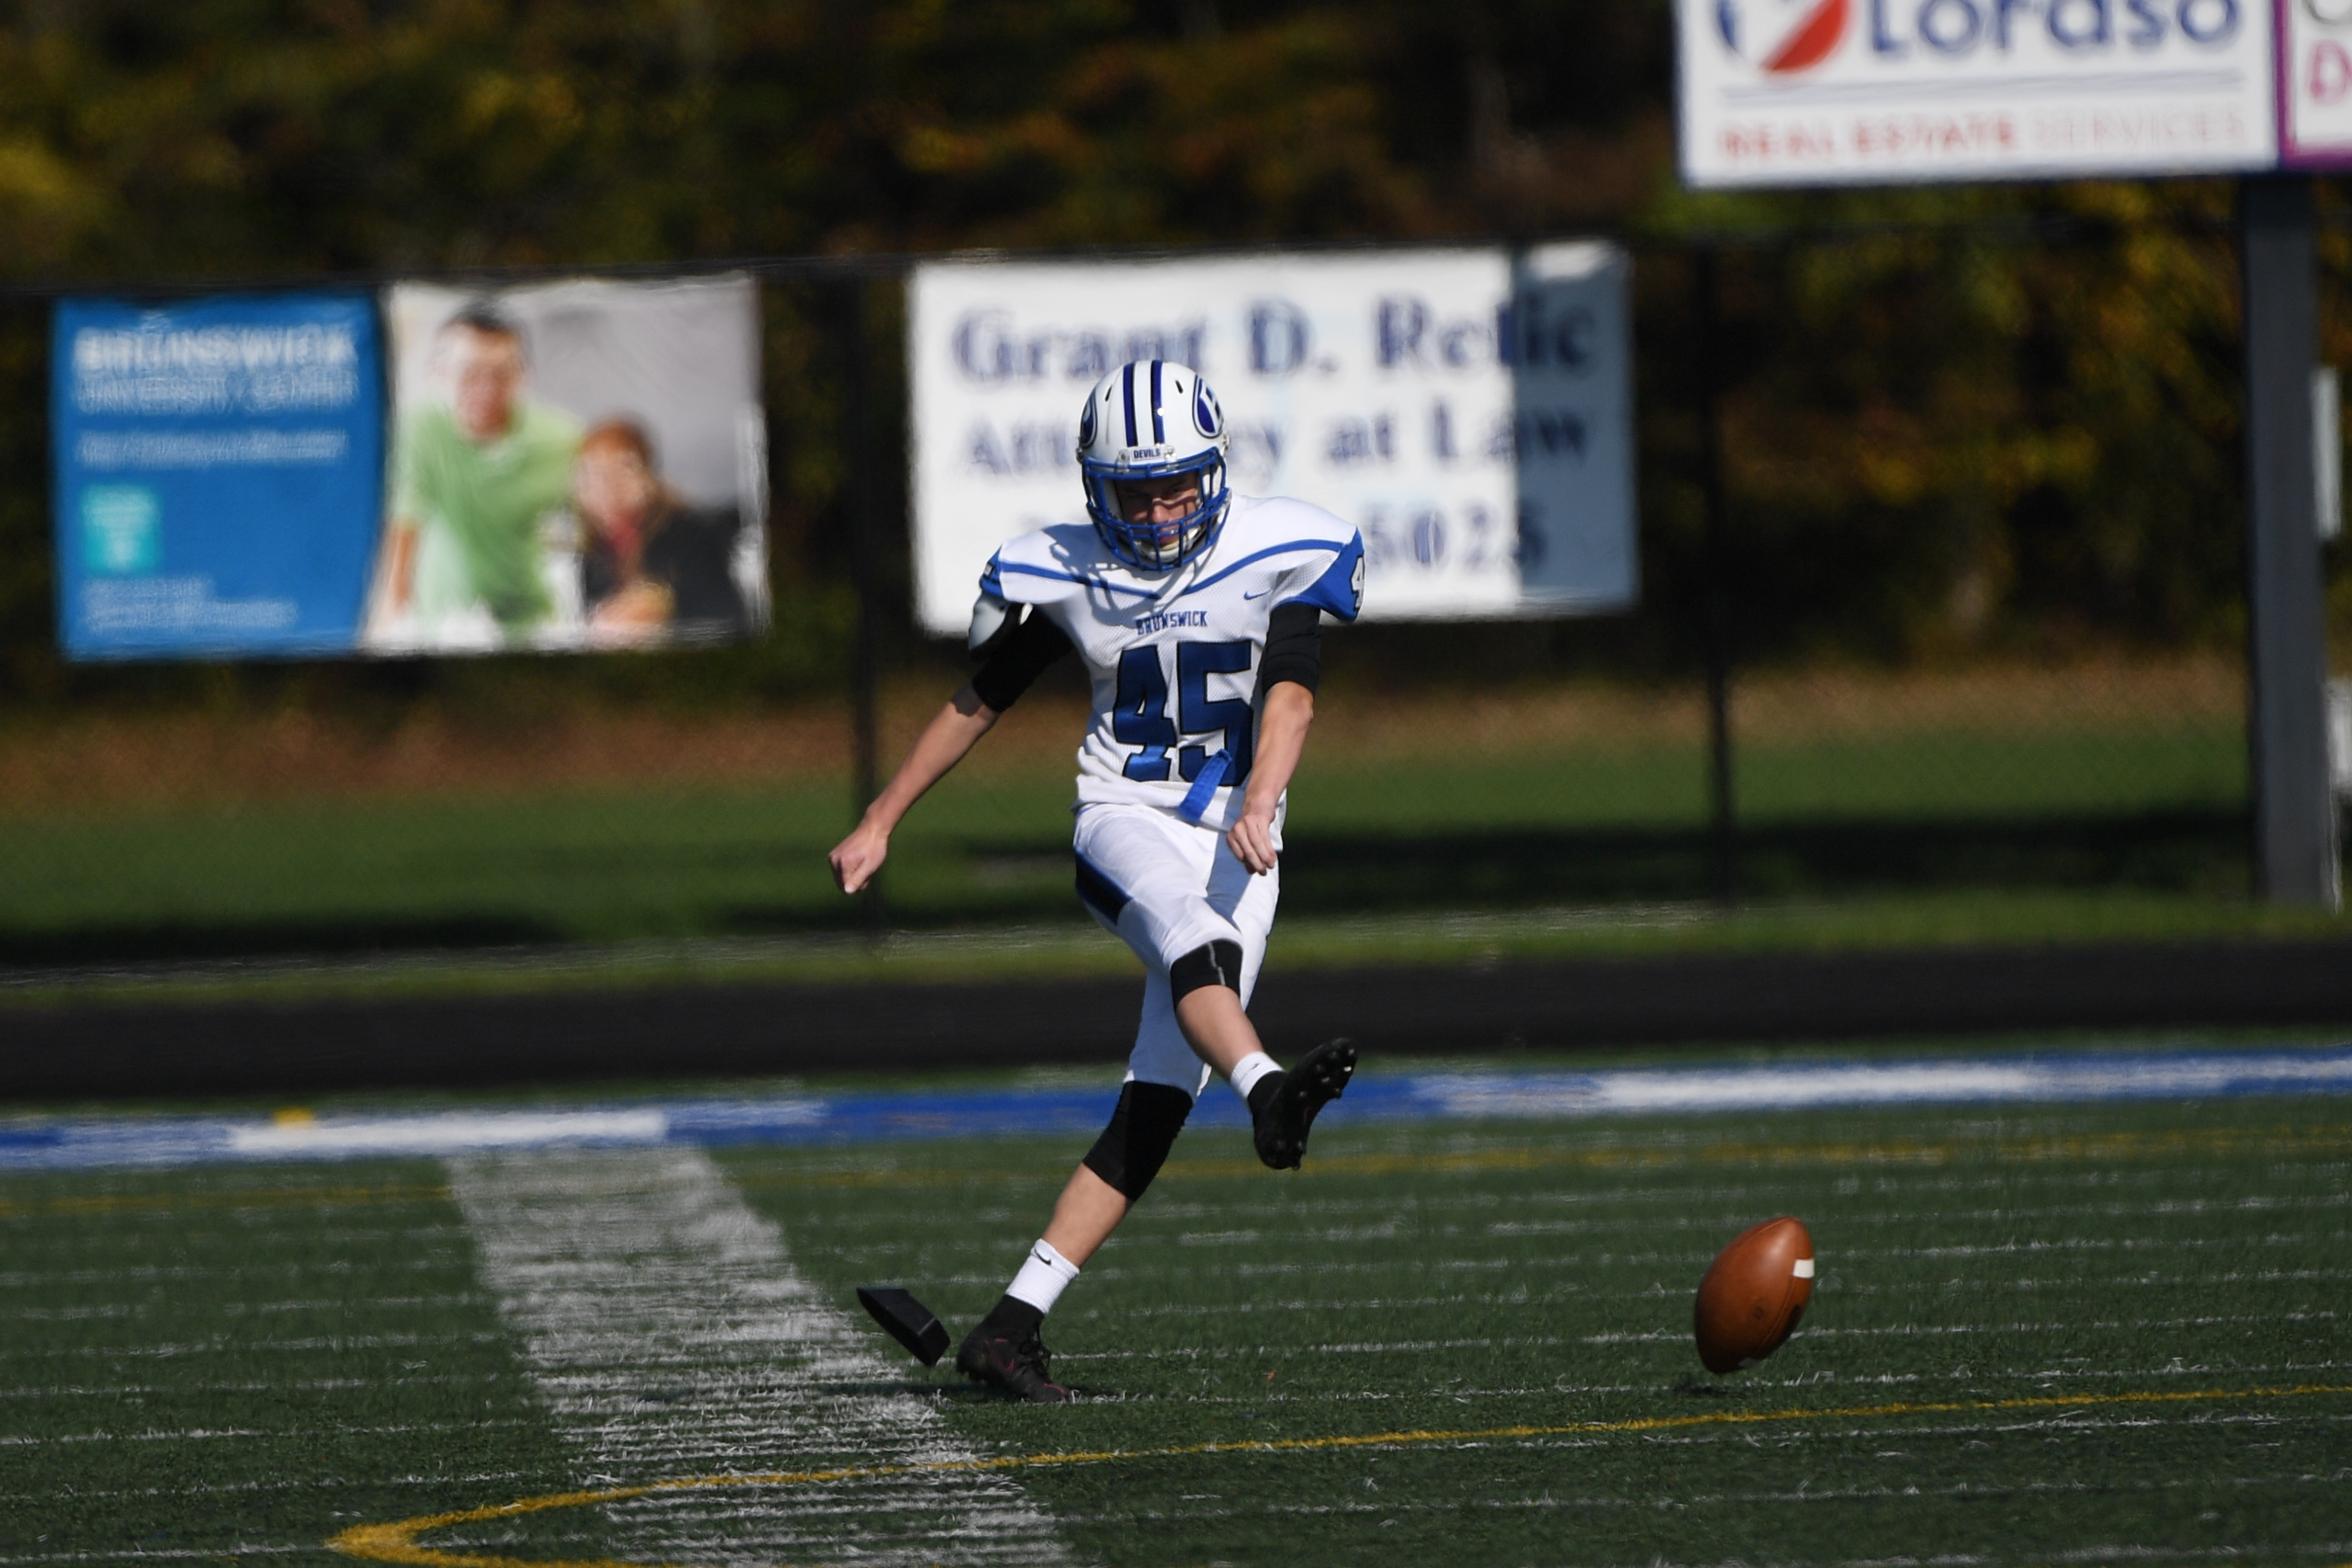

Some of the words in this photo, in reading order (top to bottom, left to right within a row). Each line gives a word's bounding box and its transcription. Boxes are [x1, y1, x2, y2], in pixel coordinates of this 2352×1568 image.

[1133, 447, 1162, 460] DEVILS
[1135, 610, 1207, 635] BRUNSWICK
[1111, 639, 1255, 787] 45
